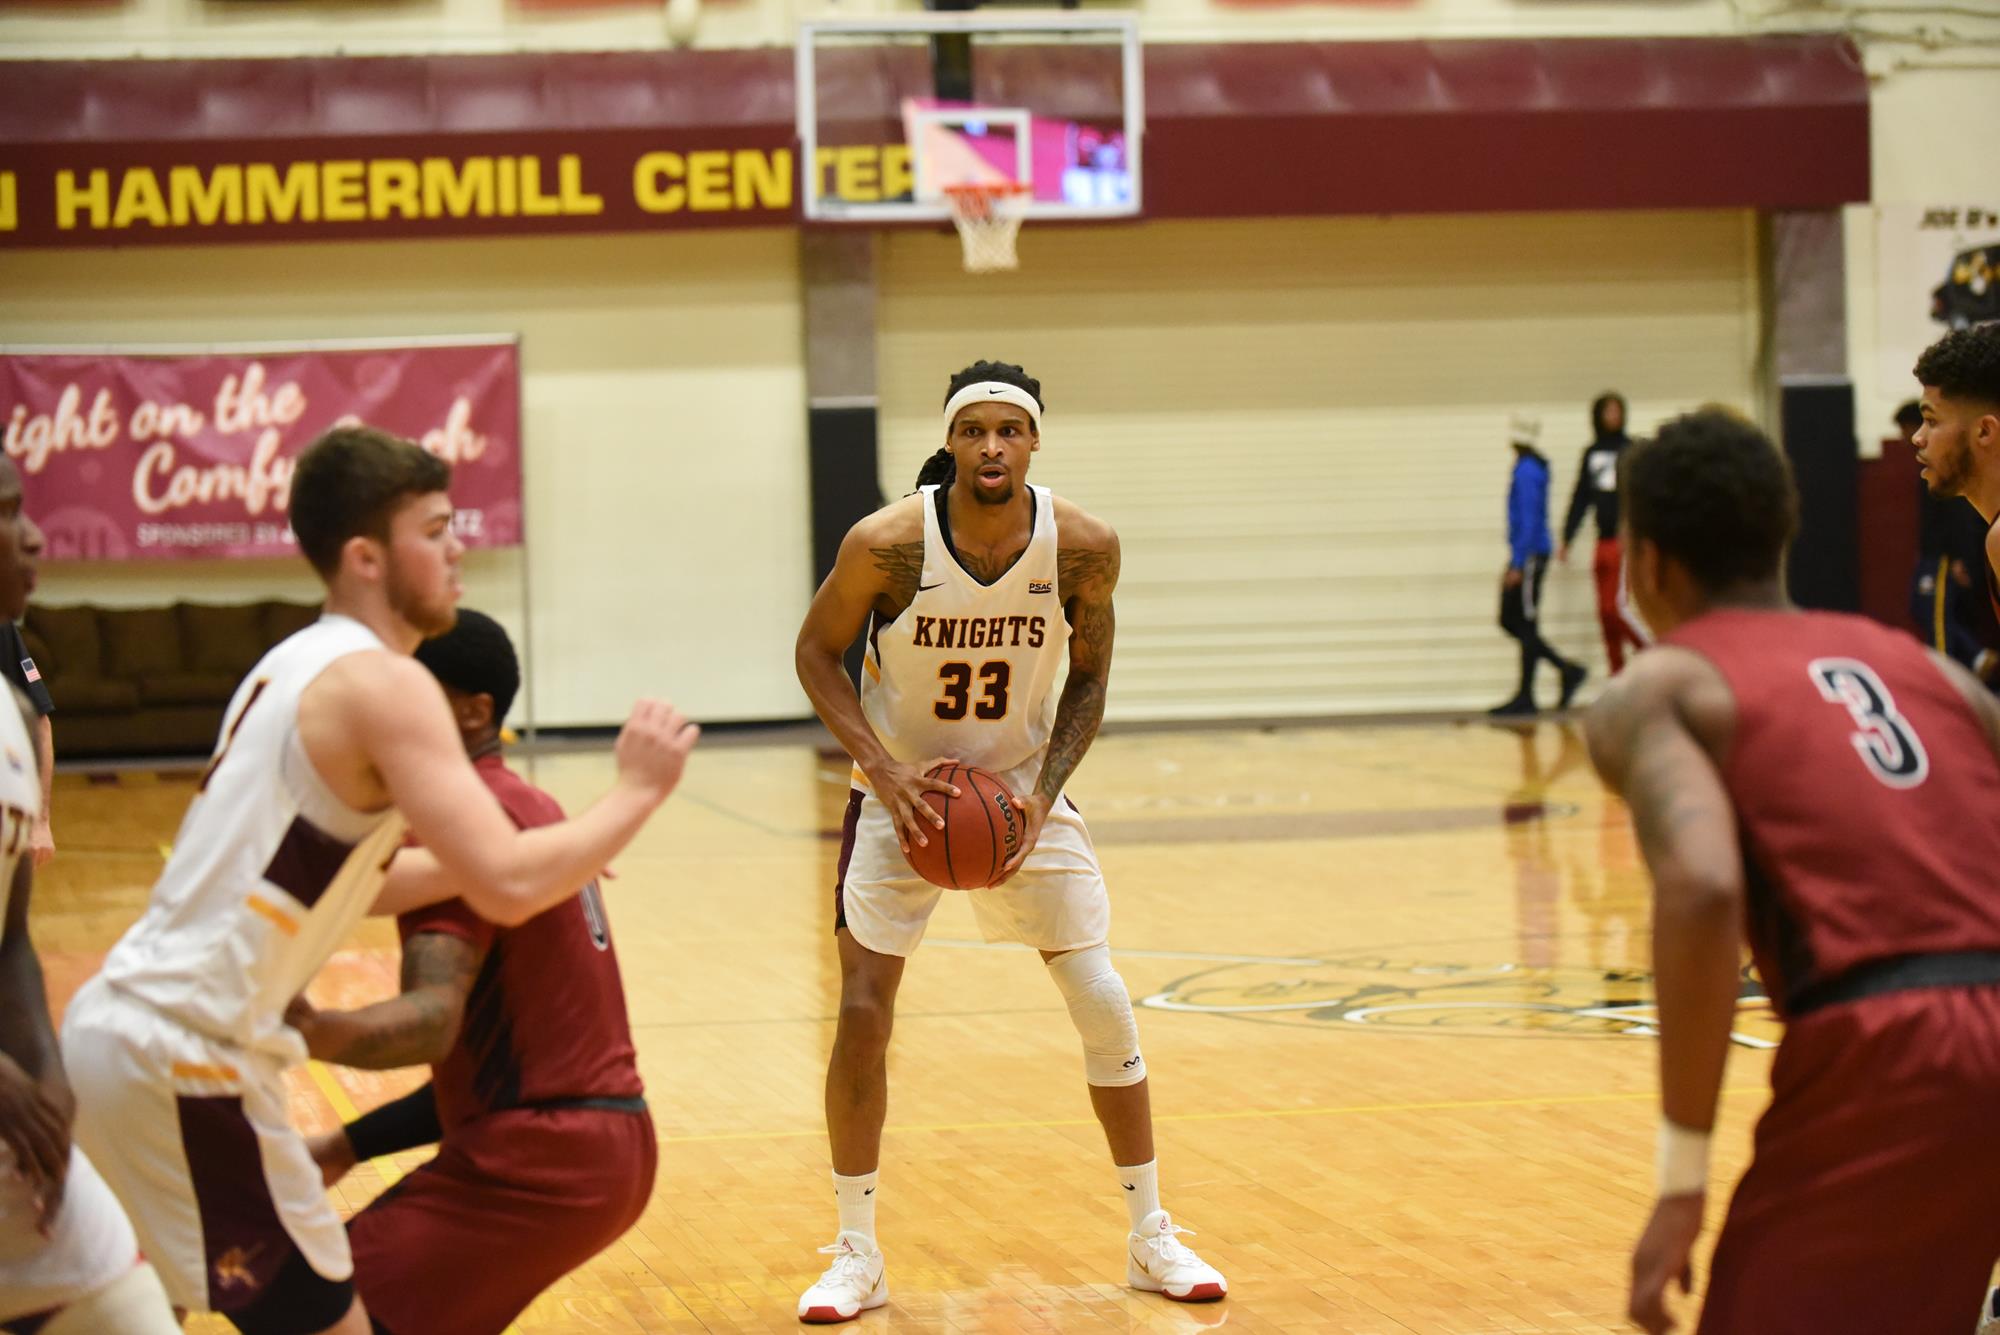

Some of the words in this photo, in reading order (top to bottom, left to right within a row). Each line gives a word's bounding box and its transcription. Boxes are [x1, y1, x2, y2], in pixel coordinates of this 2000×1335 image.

[55, 153, 604, 230] HAMMERMILL
[129, 401, 205, 441] on
[214, 362, 307, 434] the
[913, 615, 1046, 648] KNIGHTS
[932, 660, 1012, 723] 33
[1808, 656, 1930, 790] 3
